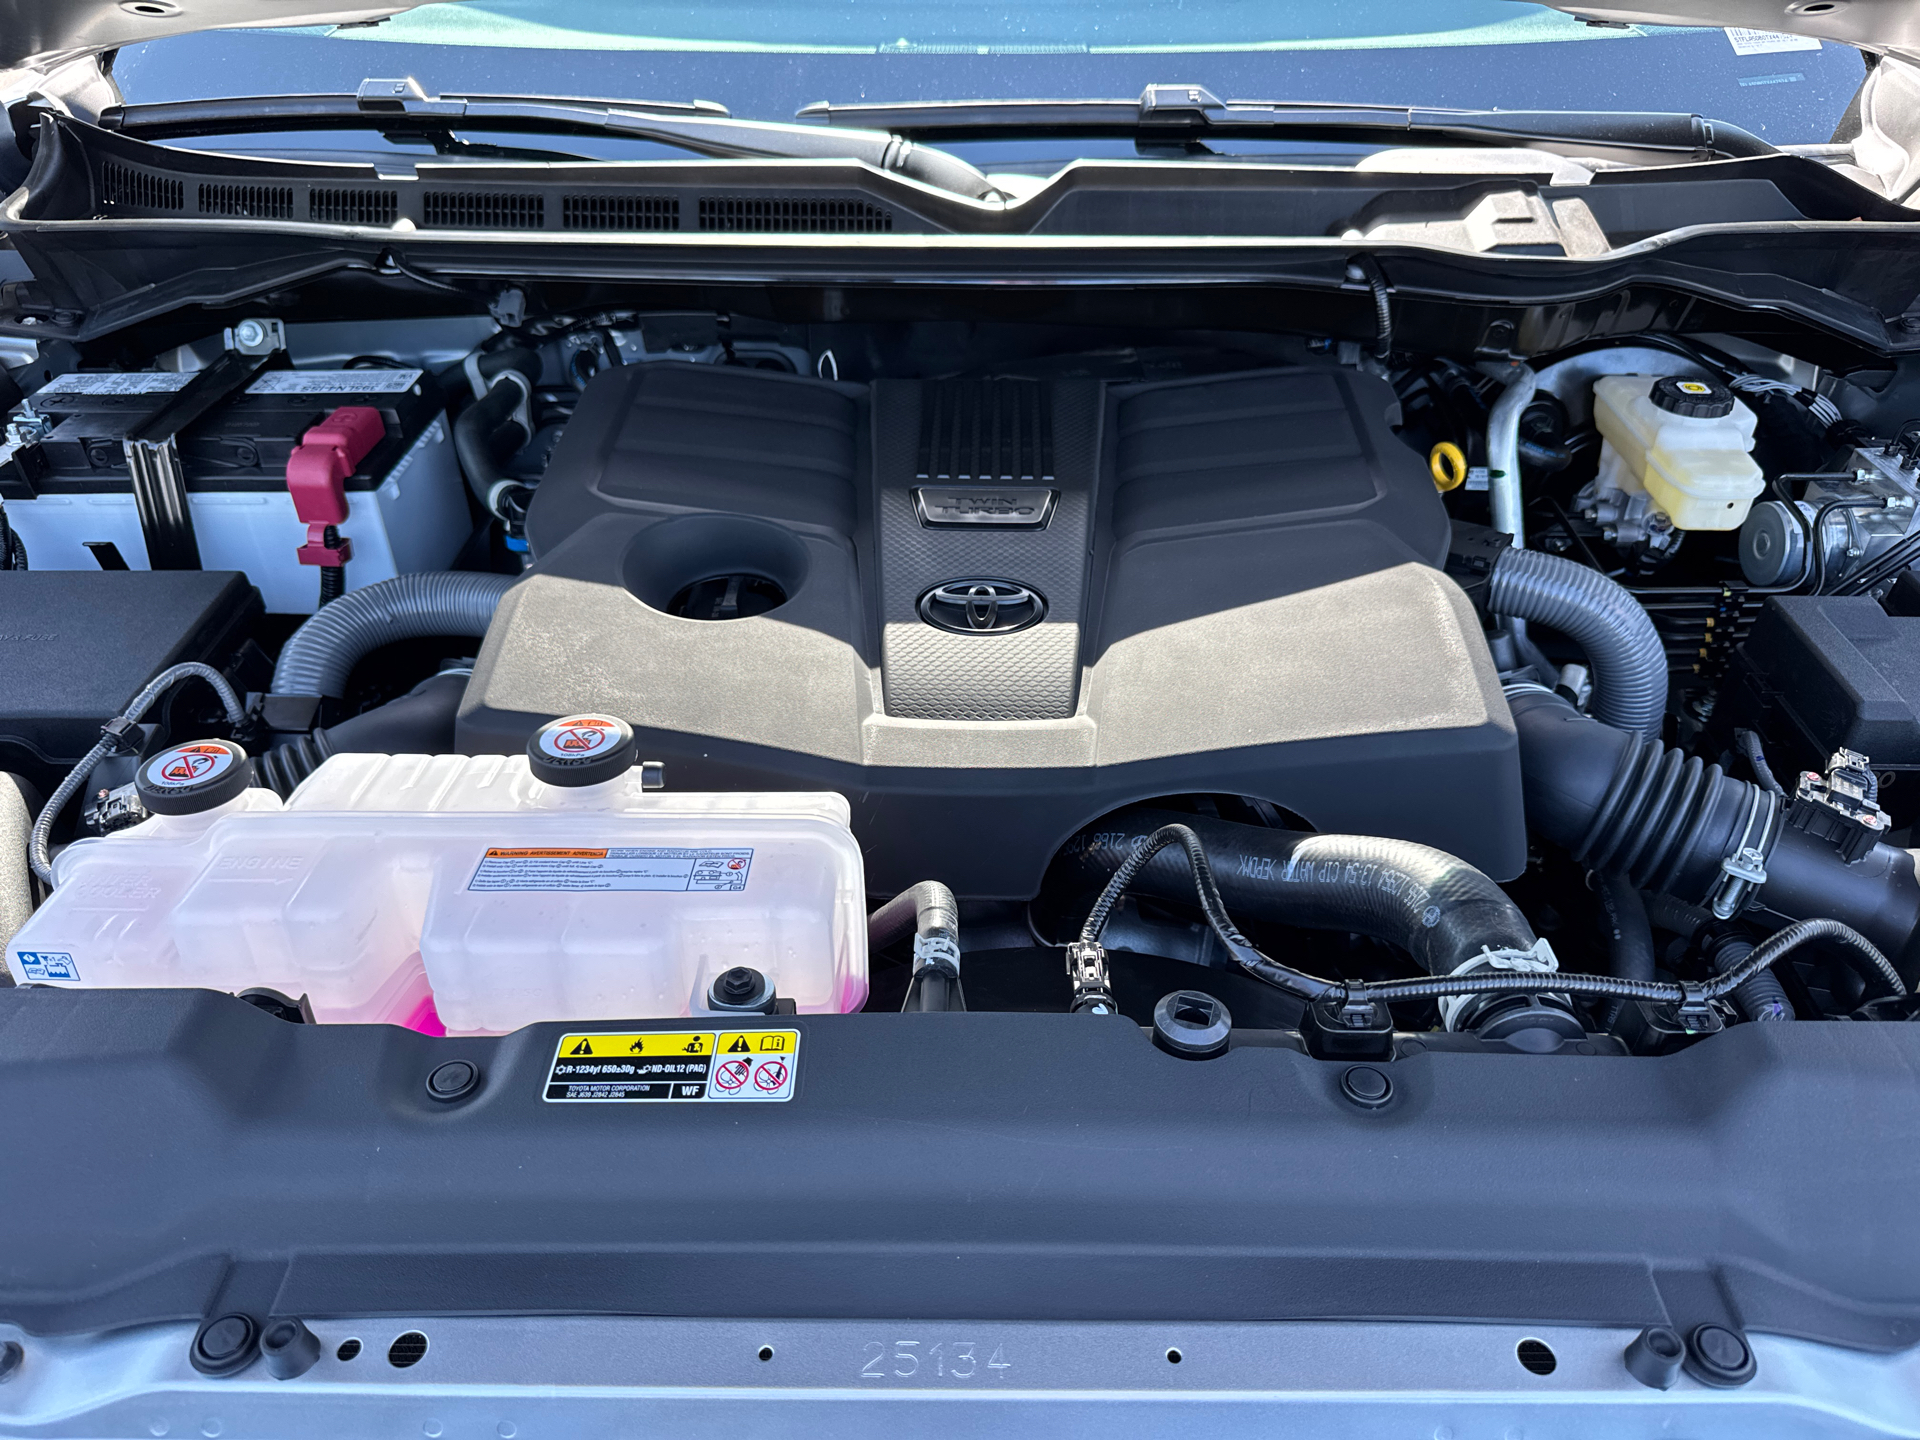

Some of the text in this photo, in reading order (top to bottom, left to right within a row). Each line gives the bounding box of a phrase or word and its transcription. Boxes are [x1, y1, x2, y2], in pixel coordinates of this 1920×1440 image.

[948, 498, 1017, 506] TWIN
[935, 506, 1034, 515] TURBO
[218, 855, 304, 870] ENGINE
[566, 1064, 601, 1075] R-1234yf
[602, 1064, 635, 1075] 650±30g
[685, 1063, 707, 1074] (PAG)
[682, 1085, 699, 1096] WF
[861, 1341, 1011, 1379] 25134
